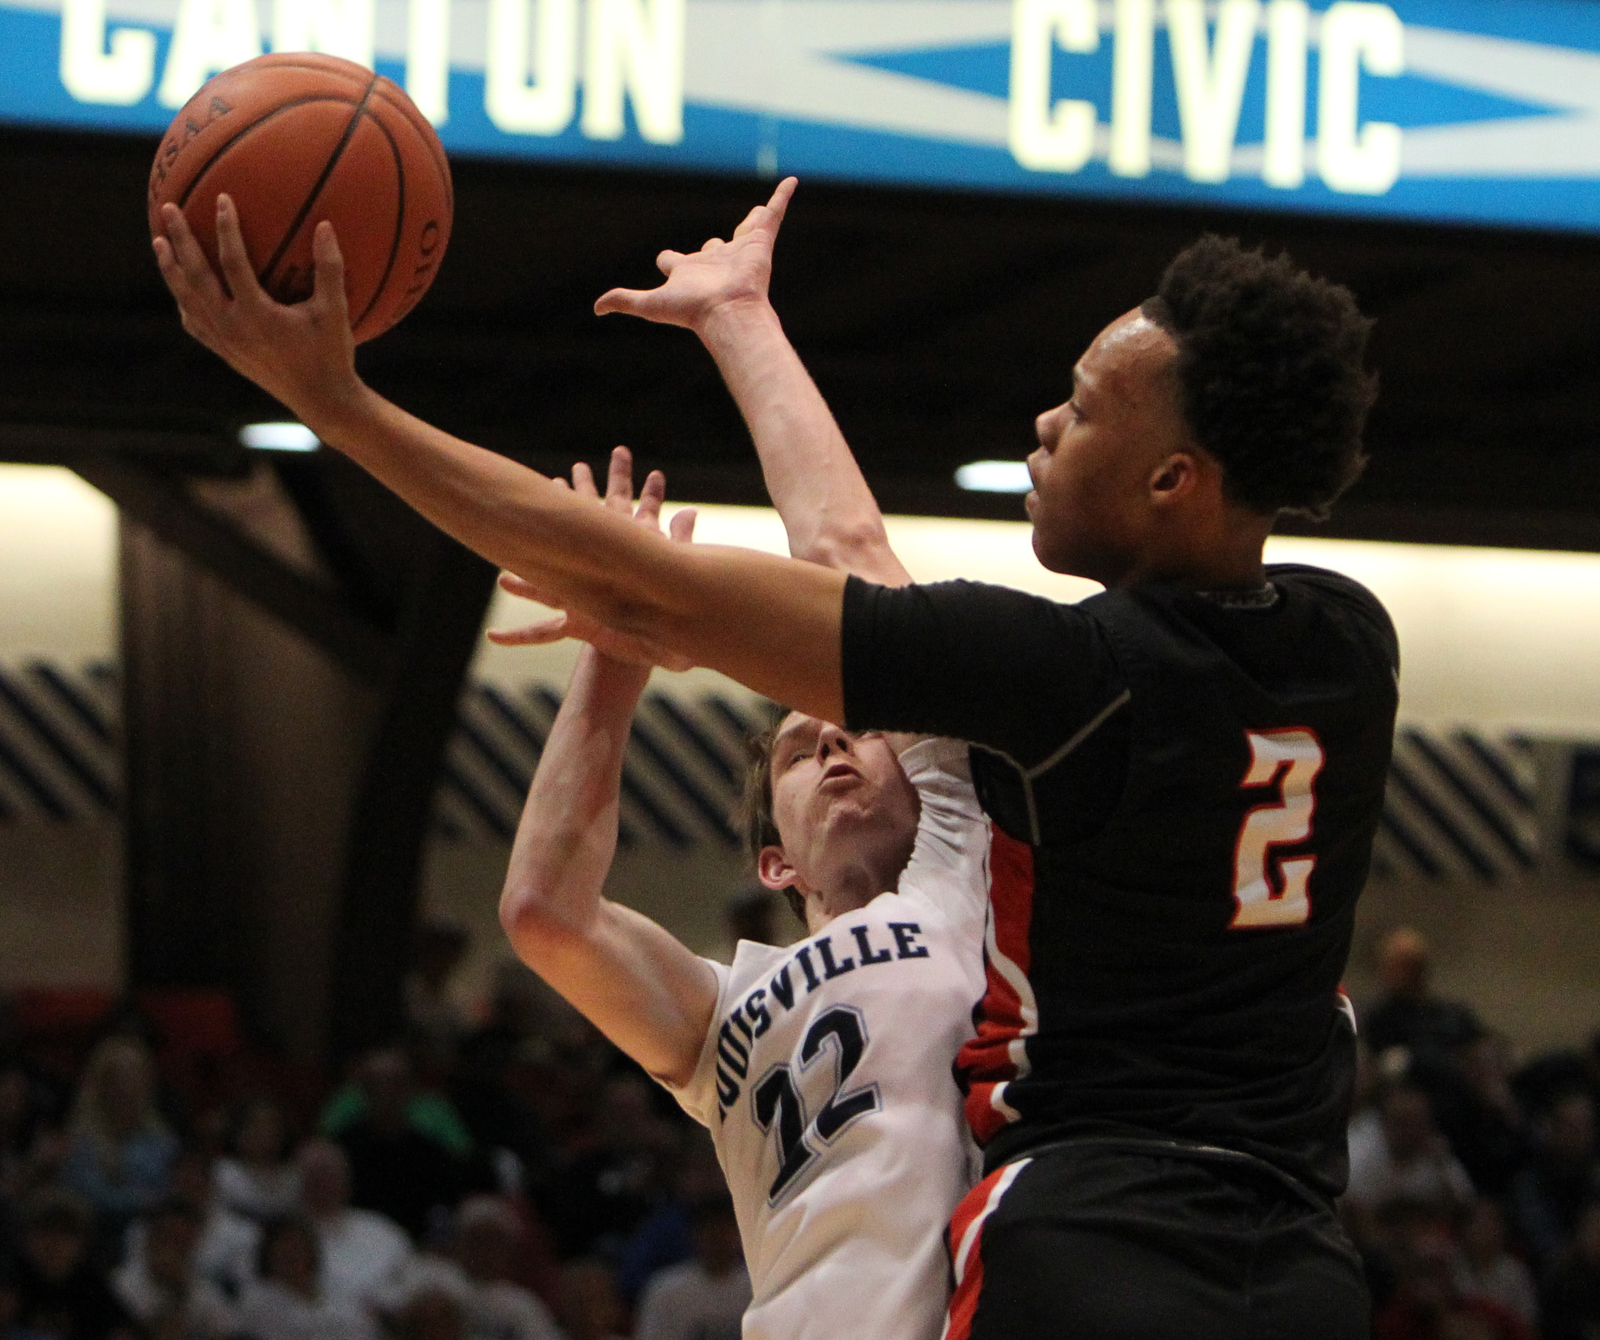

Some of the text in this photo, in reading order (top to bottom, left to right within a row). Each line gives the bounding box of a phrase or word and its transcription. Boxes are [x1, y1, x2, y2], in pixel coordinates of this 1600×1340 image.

[59, 0, 1402, 196] CTON CIVIC
[1227, 726, 1326, 930] 2
[716, 921, 931, 1124] OUISVILLE
